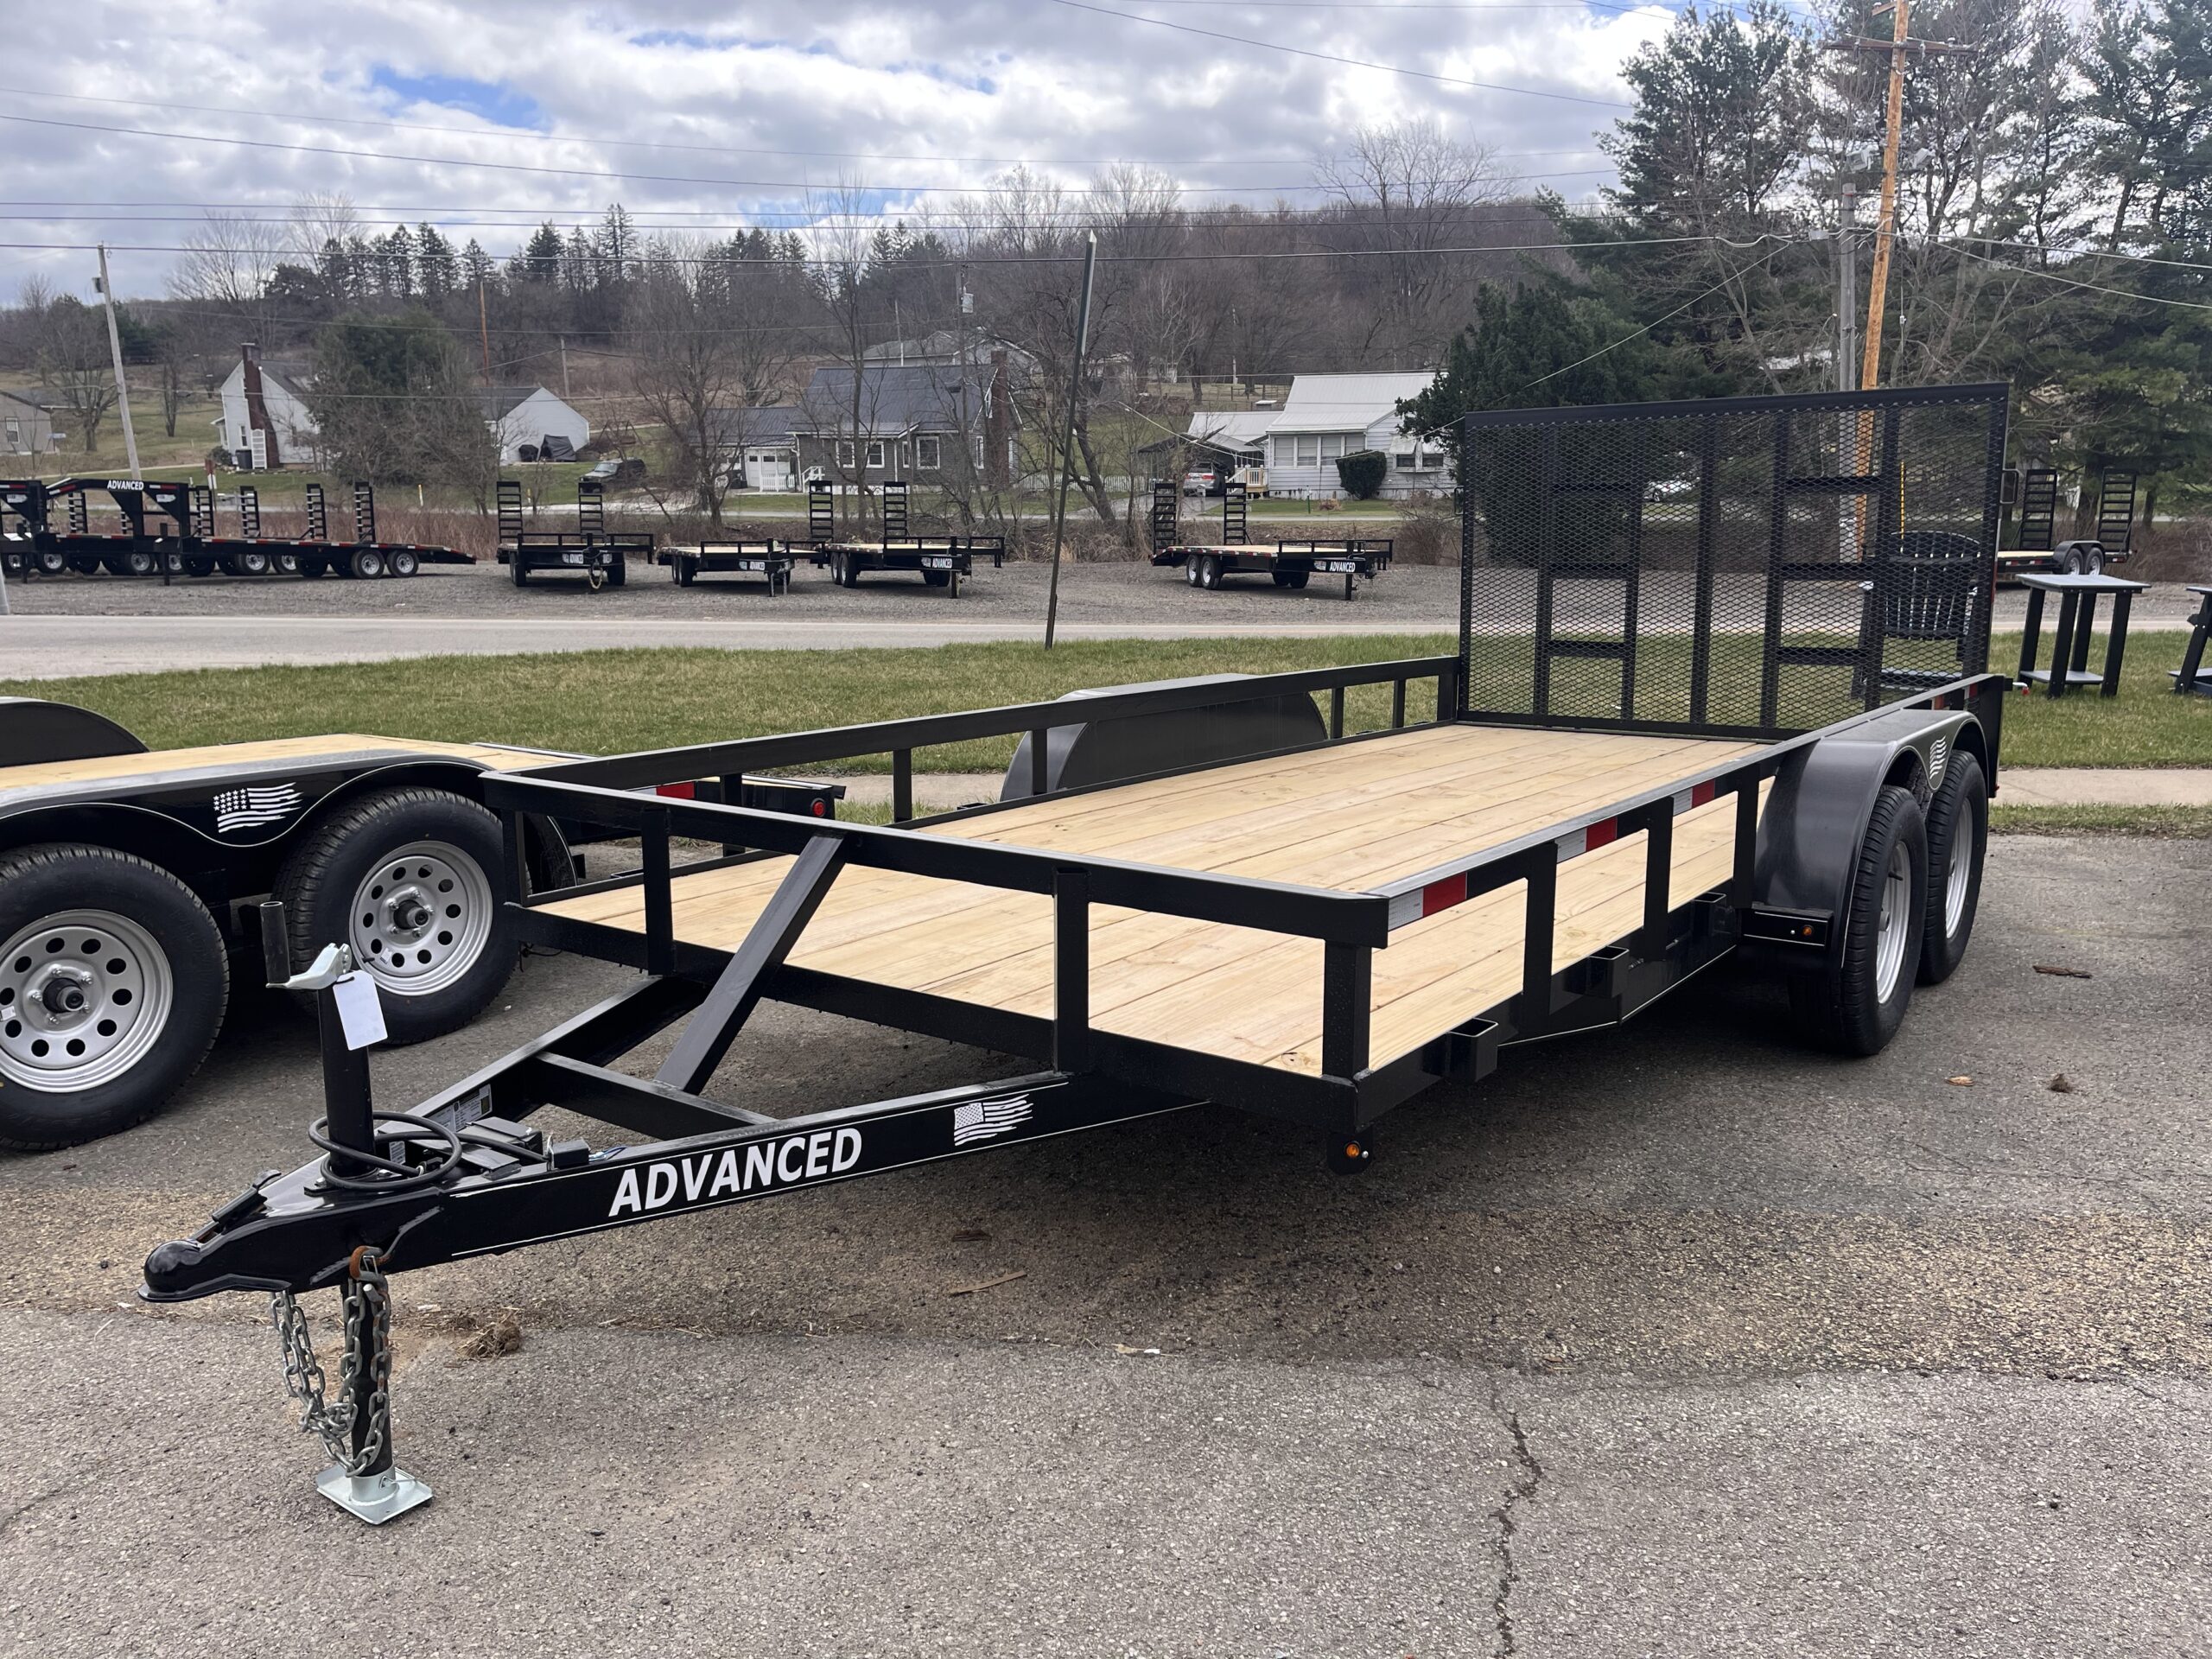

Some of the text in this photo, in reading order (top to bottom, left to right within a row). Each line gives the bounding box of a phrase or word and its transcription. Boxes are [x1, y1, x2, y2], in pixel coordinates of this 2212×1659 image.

[107, 480, 144, 491] ADVANCED
[1329, 557, 1356, 573] ADVANCED
[608, 1128, 862, 1217] ADVANCED
